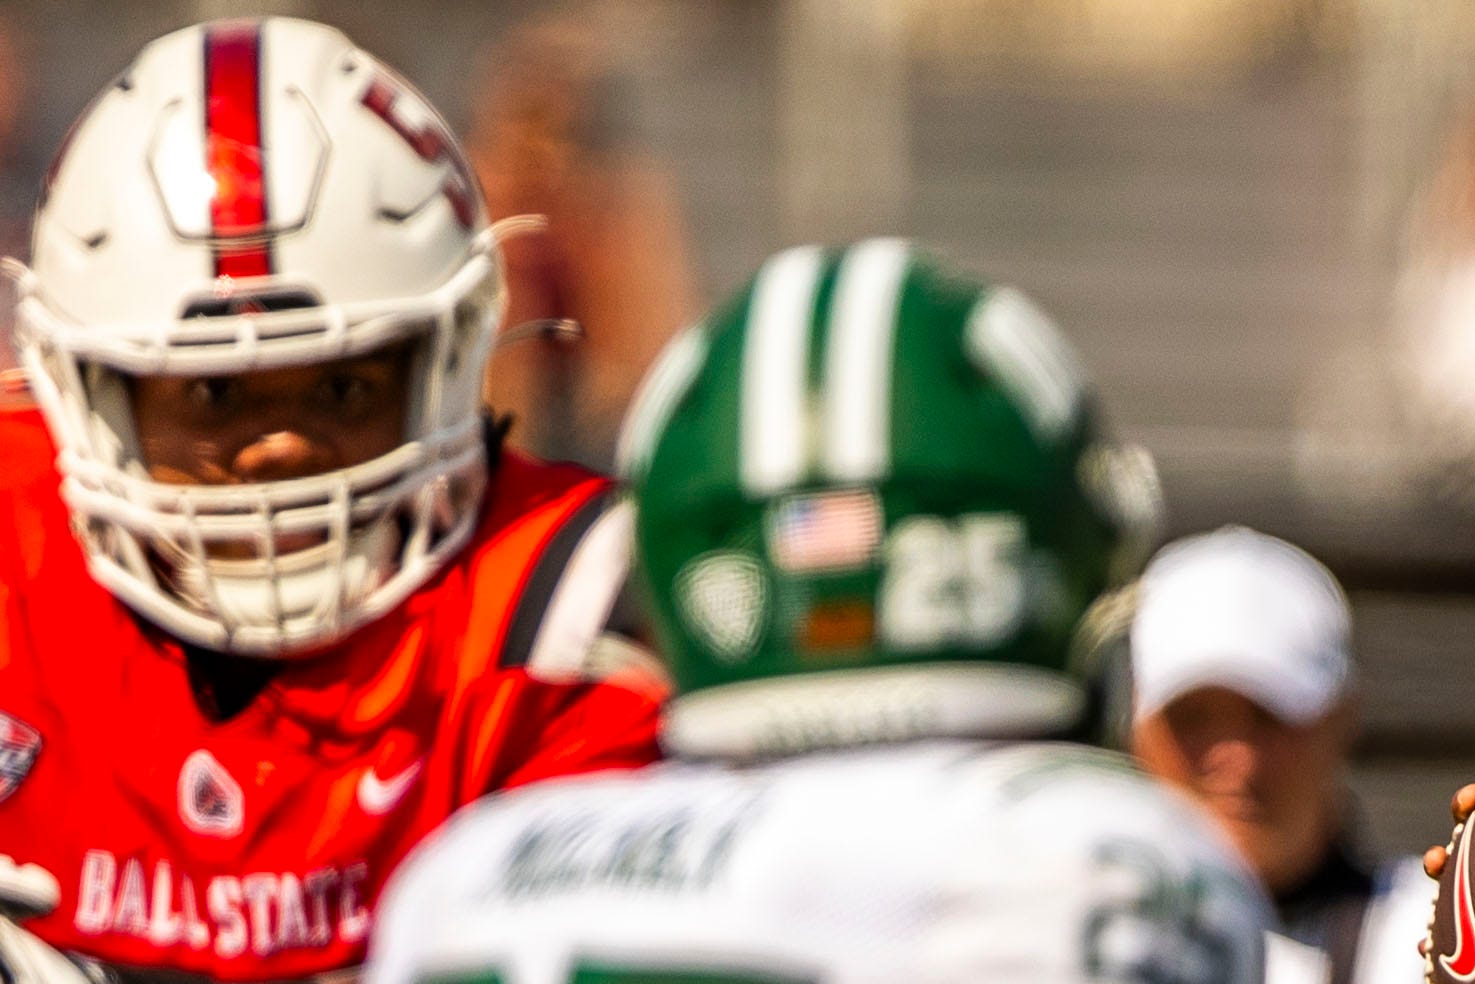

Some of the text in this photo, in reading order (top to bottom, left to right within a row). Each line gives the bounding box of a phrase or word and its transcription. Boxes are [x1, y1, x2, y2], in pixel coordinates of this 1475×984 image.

[880, 514, 1028, 648] 25
[74, 848, 370, 959] BALL STATE
